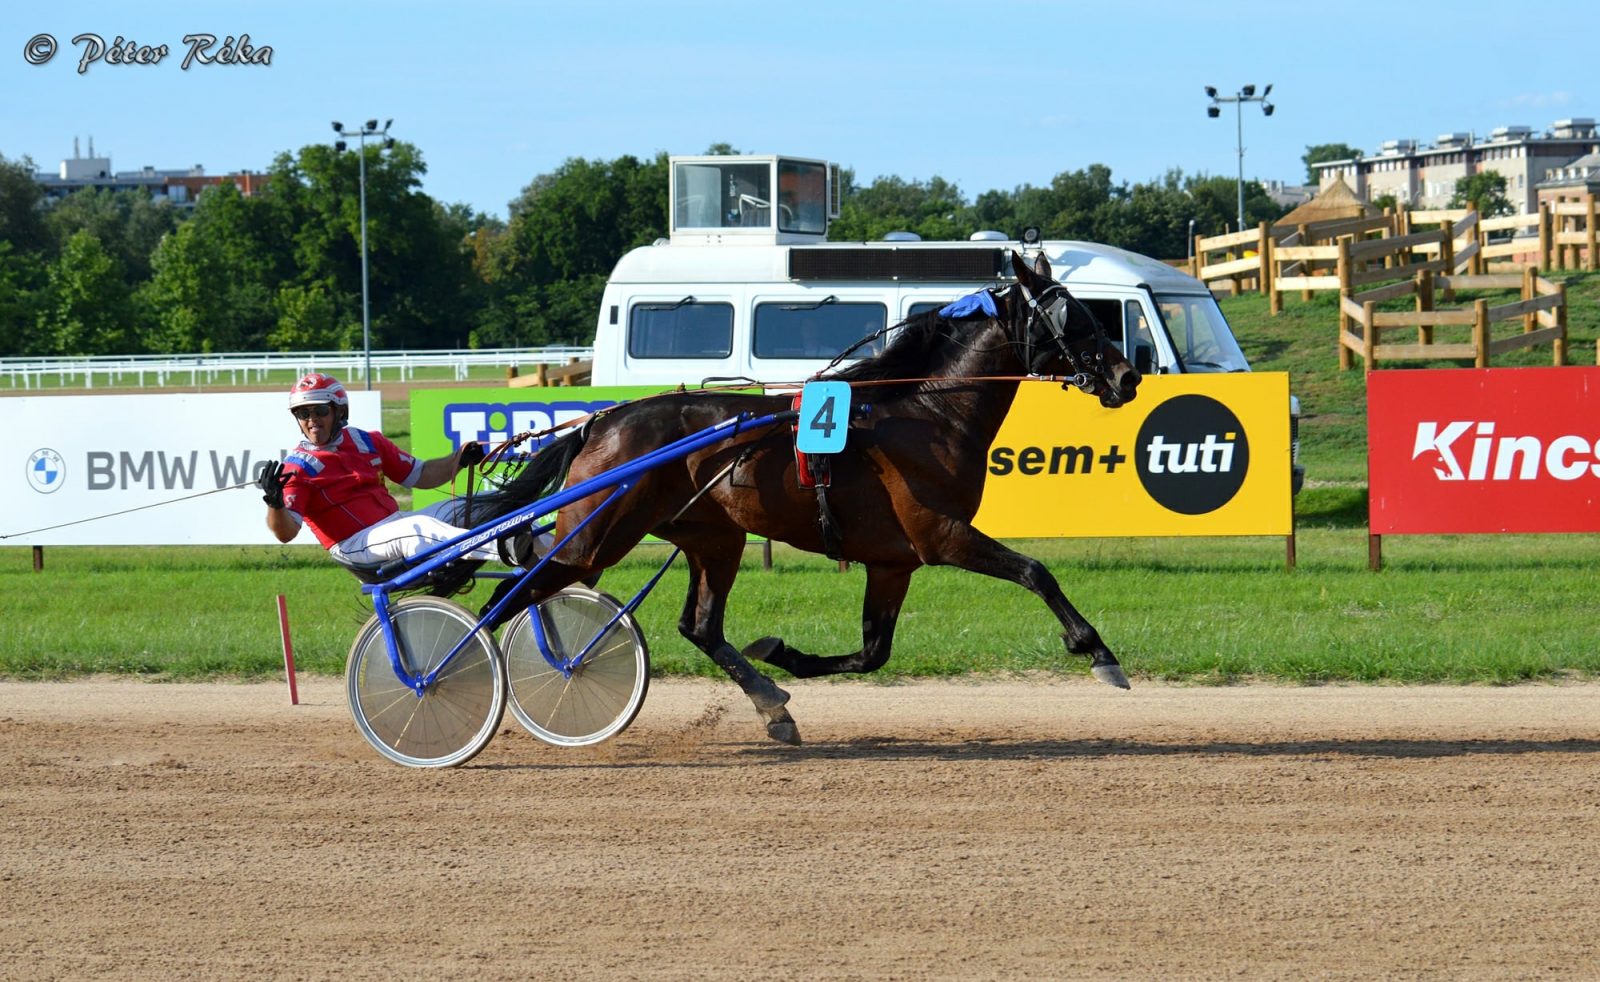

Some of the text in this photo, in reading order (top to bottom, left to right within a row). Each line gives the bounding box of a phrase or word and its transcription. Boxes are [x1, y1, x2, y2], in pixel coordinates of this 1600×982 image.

[809, 396, 837, 439] 4
[86, 450, 199, 491] BMW
[1146, 431, 1237, 474] tuti
[1411, 421, 1600, 481] Kinc
